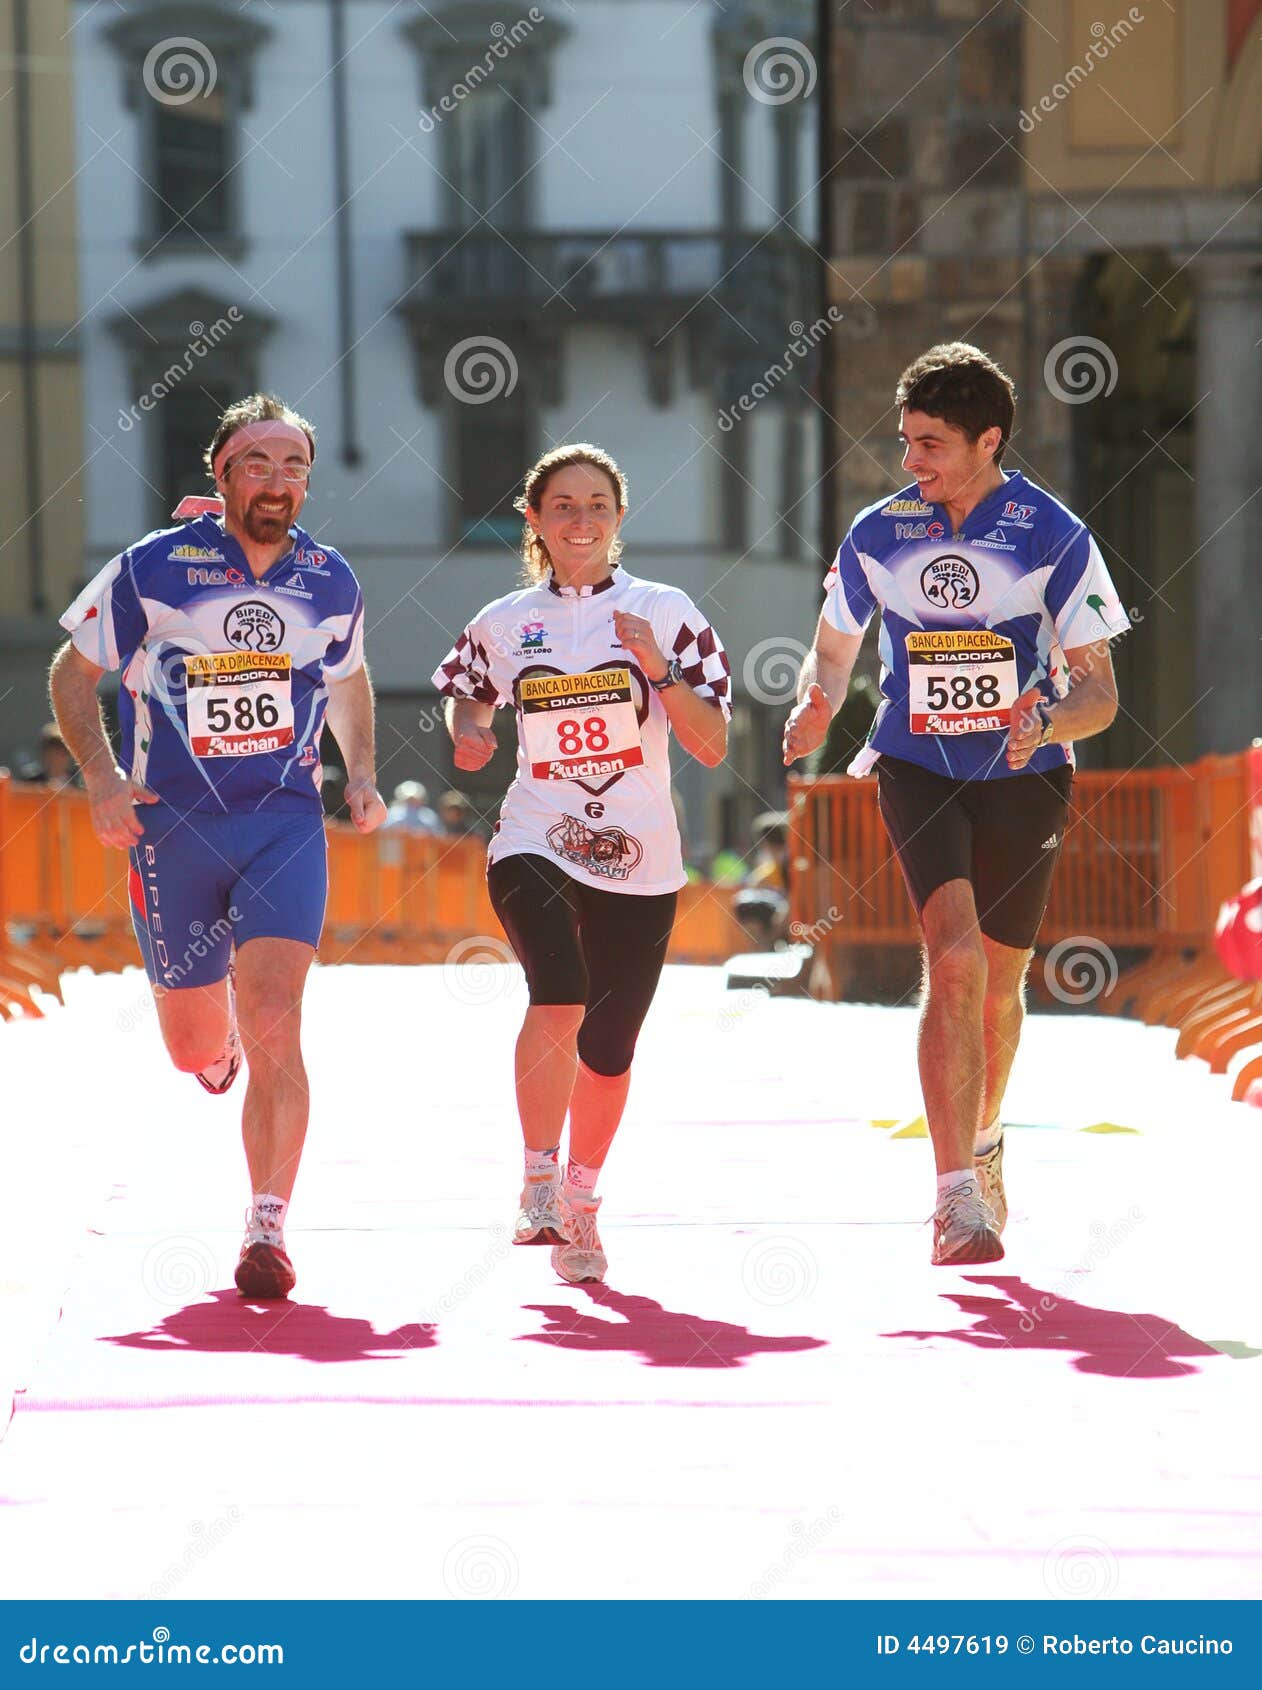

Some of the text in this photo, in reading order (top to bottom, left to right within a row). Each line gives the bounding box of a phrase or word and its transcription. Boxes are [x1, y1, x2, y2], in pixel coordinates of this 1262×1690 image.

[931, 563, 969, 575] BIPEDI
[928, 585, 971, 600] 4 2
[235, 608, 274, 622] BIPEDI
[231, 630, 276, 645] 4 2
[912, 634, 1009, 649] BANCA DI PIACENZA
[237, 654, 286, 669] PIACENZA
[934, 652, 1004, 662] DIADORA
[217, 671, 280, 683] DIADORA
[526, 673, 625, 697] BANCA DI PIACENZA
[550, 692, 621, 708] DIADORA
[927, 674, 1001, 711] 588
[207, 693, 279, 733] 586
[925, 714, 1001, 733] Auchan
[557, 717, 609, 755] 88
[207, 736, 279, 755] Auchan
[548, 758, 624, 780] Auchan
[145, 844, 172, 979] BIPEDI
